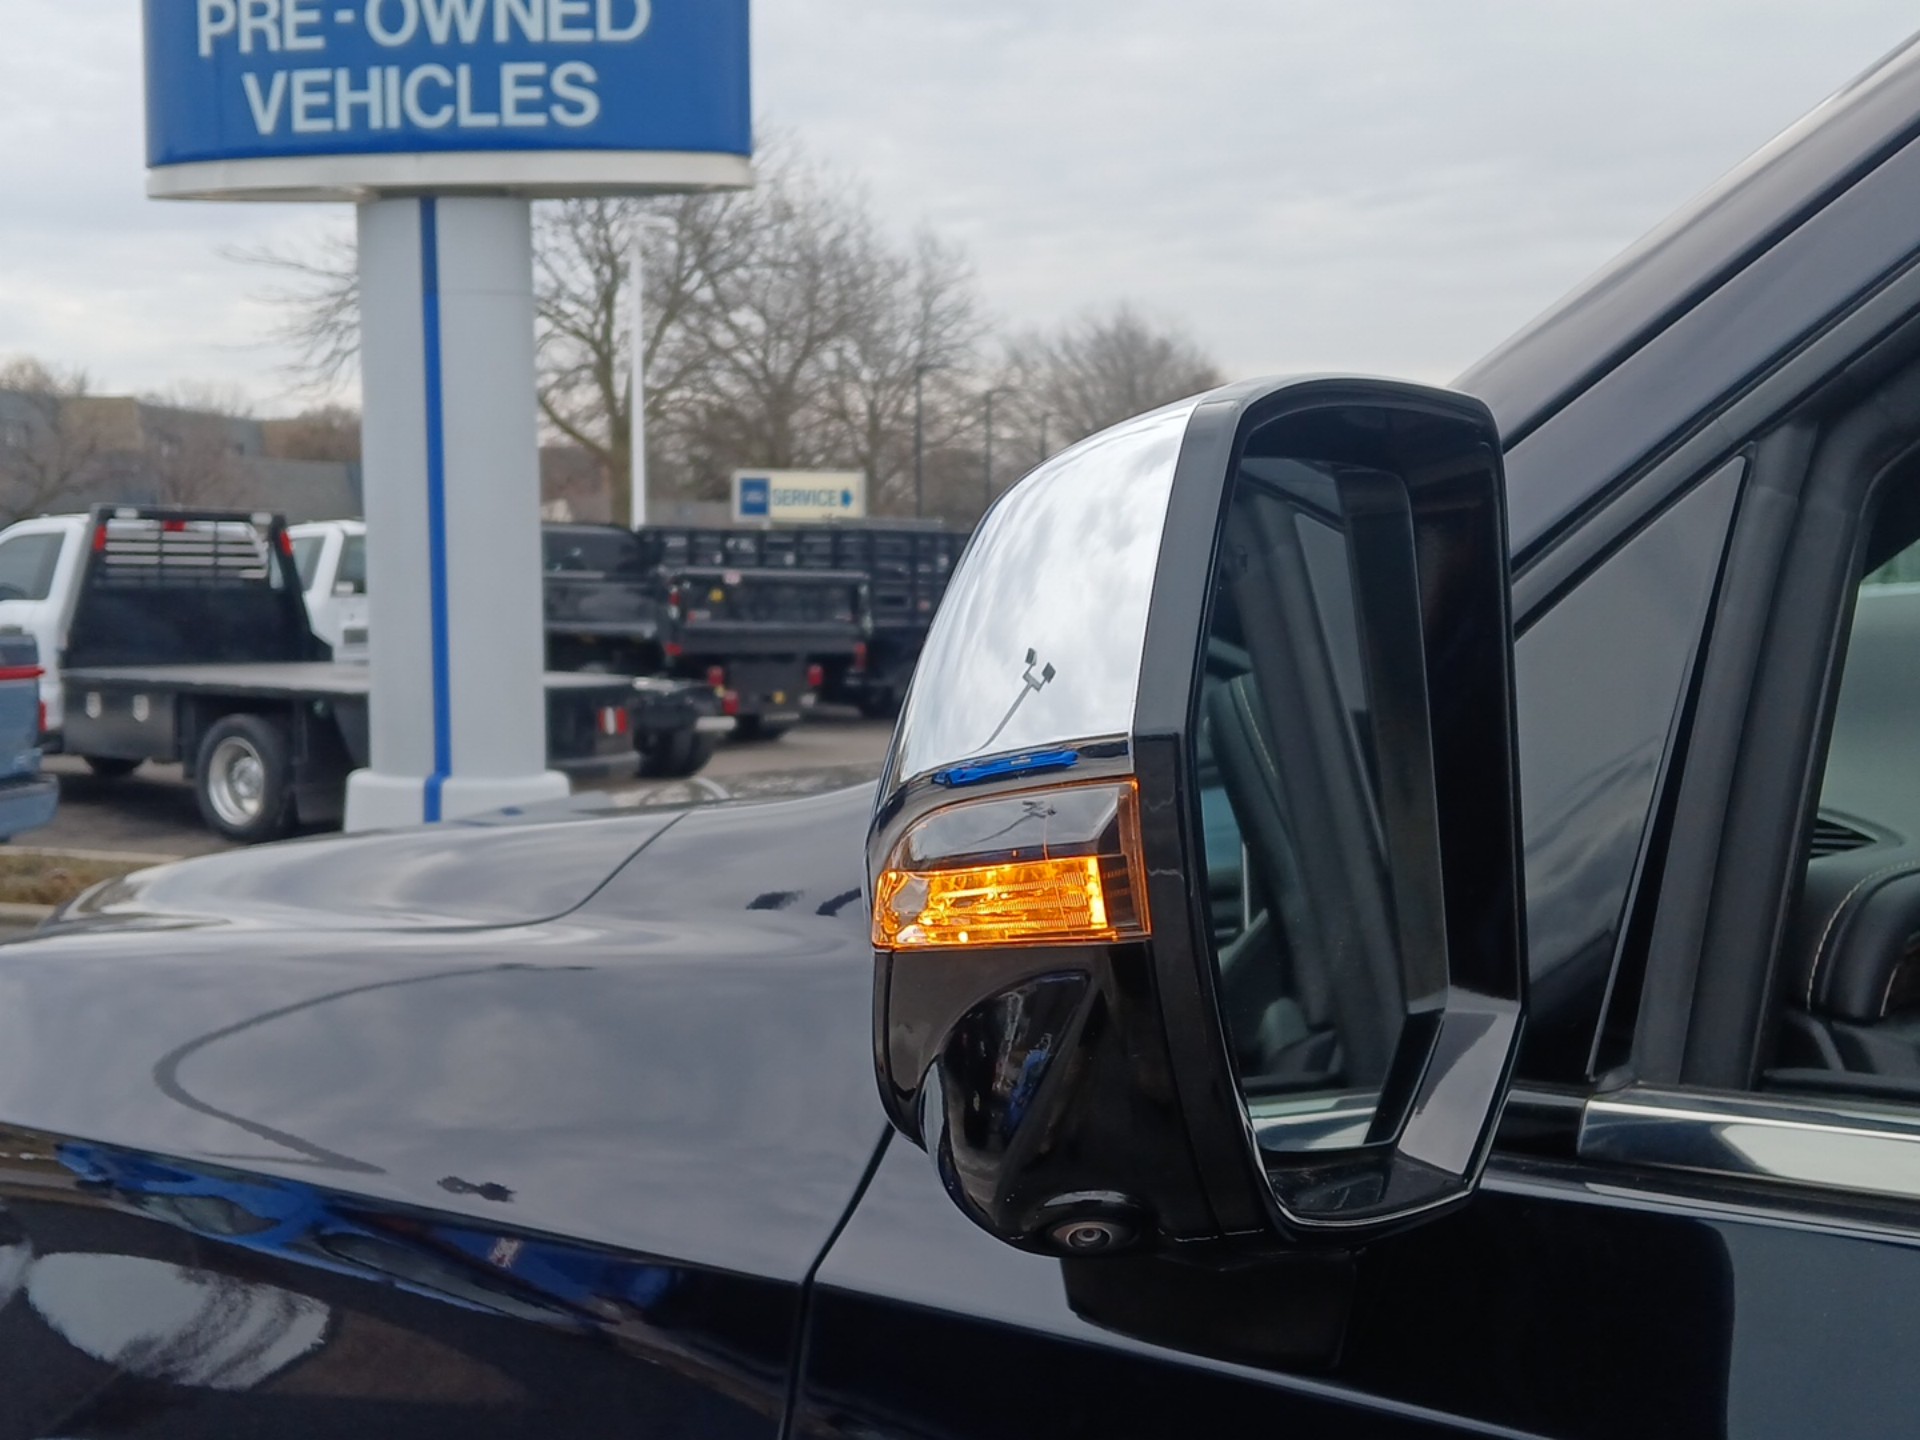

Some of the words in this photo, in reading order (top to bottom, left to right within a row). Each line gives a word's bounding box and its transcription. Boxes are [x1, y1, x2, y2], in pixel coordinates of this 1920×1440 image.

[197, 0, 652, 57] PRE-OWNED
[241, 61, 601, 135] VEHICLES
[772, 488, 838, 507] SERVICE
